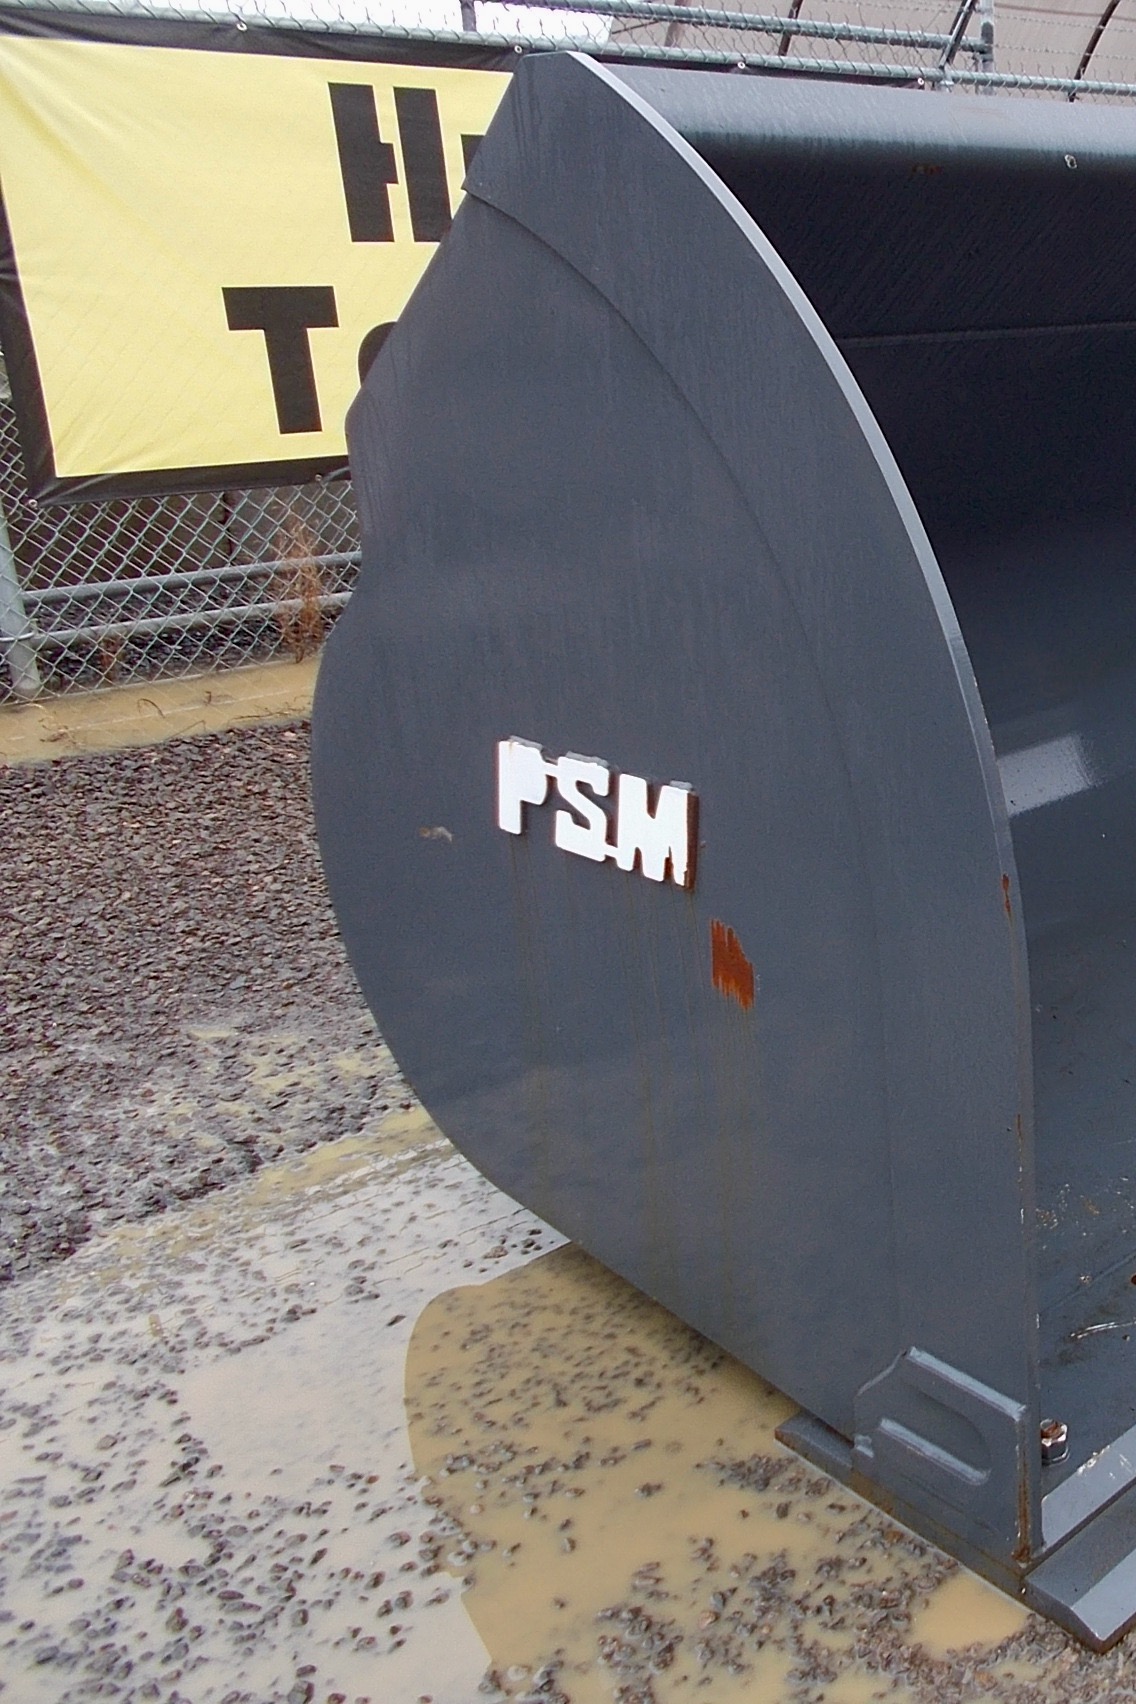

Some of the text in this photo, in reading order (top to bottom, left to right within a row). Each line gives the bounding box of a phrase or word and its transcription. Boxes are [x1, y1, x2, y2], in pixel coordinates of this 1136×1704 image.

[327, 82, 486, 242] H
[221, 286, 397, 434] T
[497, 737, 698, 888] PSM
